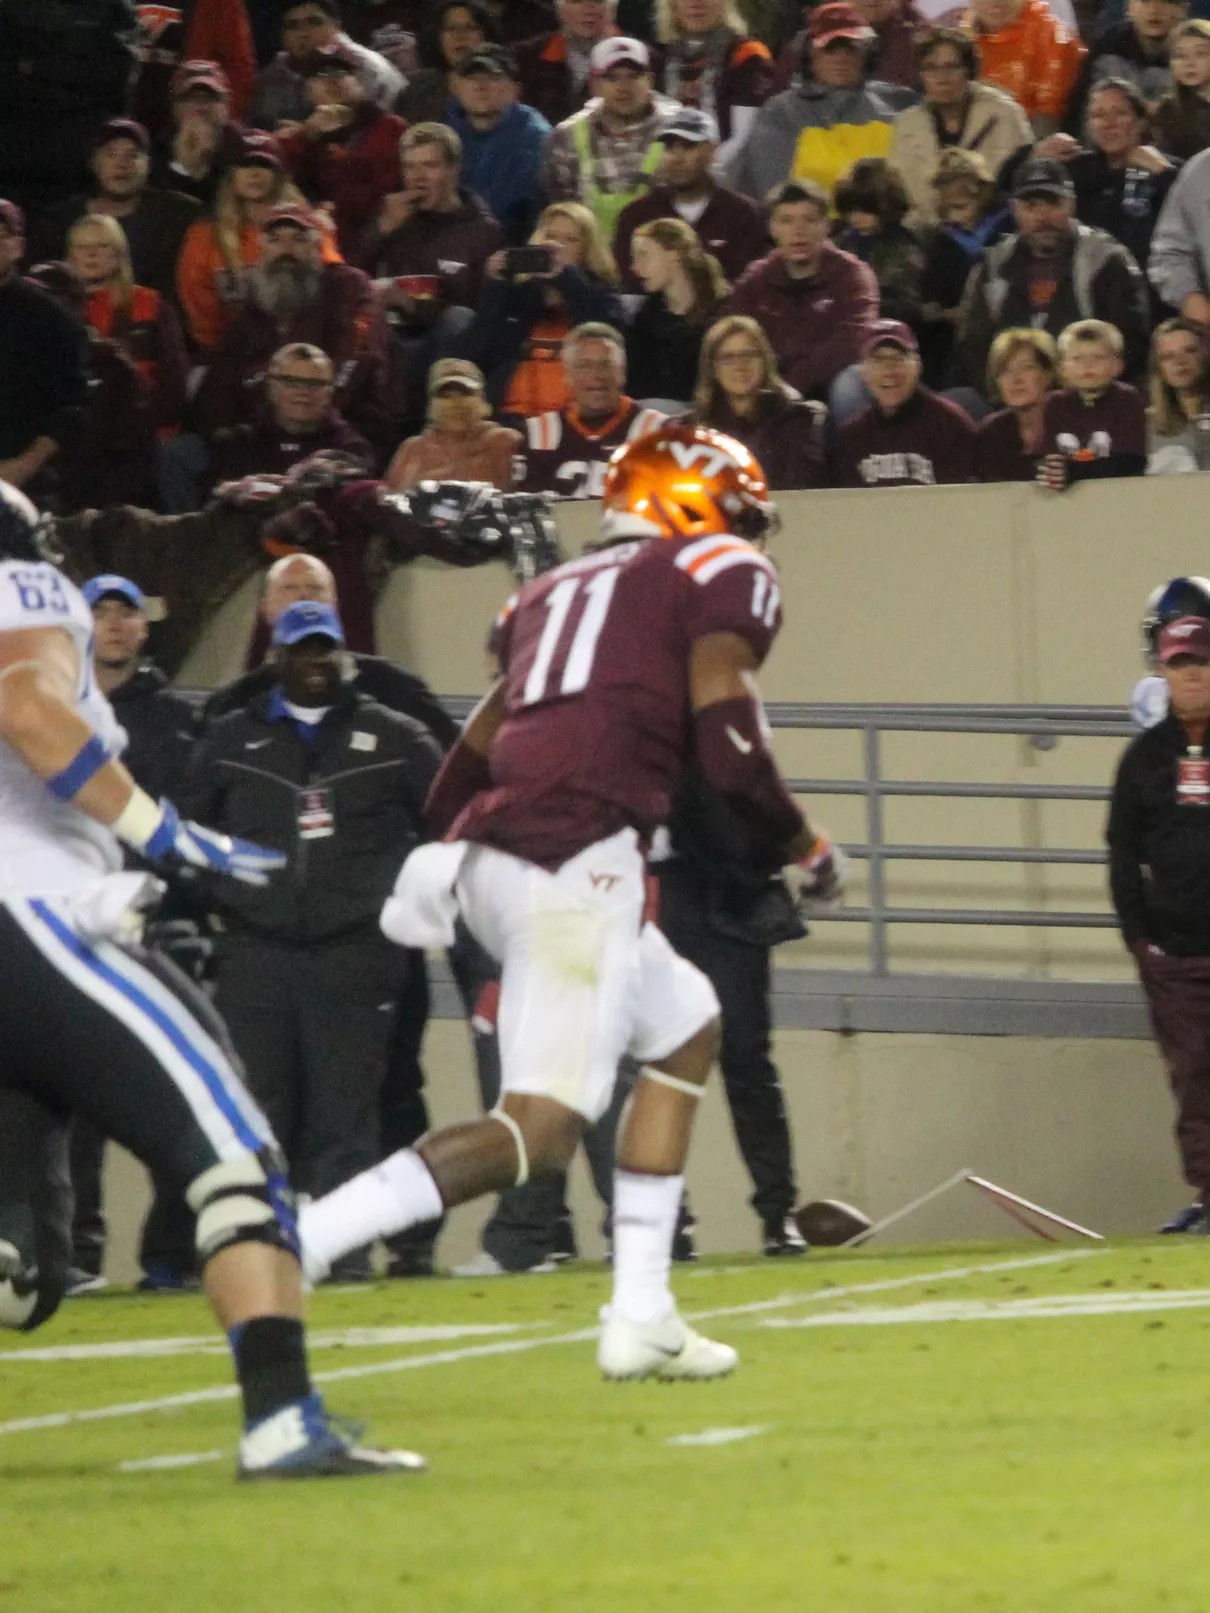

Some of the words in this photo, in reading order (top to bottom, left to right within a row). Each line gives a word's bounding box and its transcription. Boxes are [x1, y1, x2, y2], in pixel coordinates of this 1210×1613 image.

[667, 441, 742, 478] VT
[751, 570, 781, 628] 11
[523, 564, 620, 703] 11
[586, 869, 625, 895] VT
